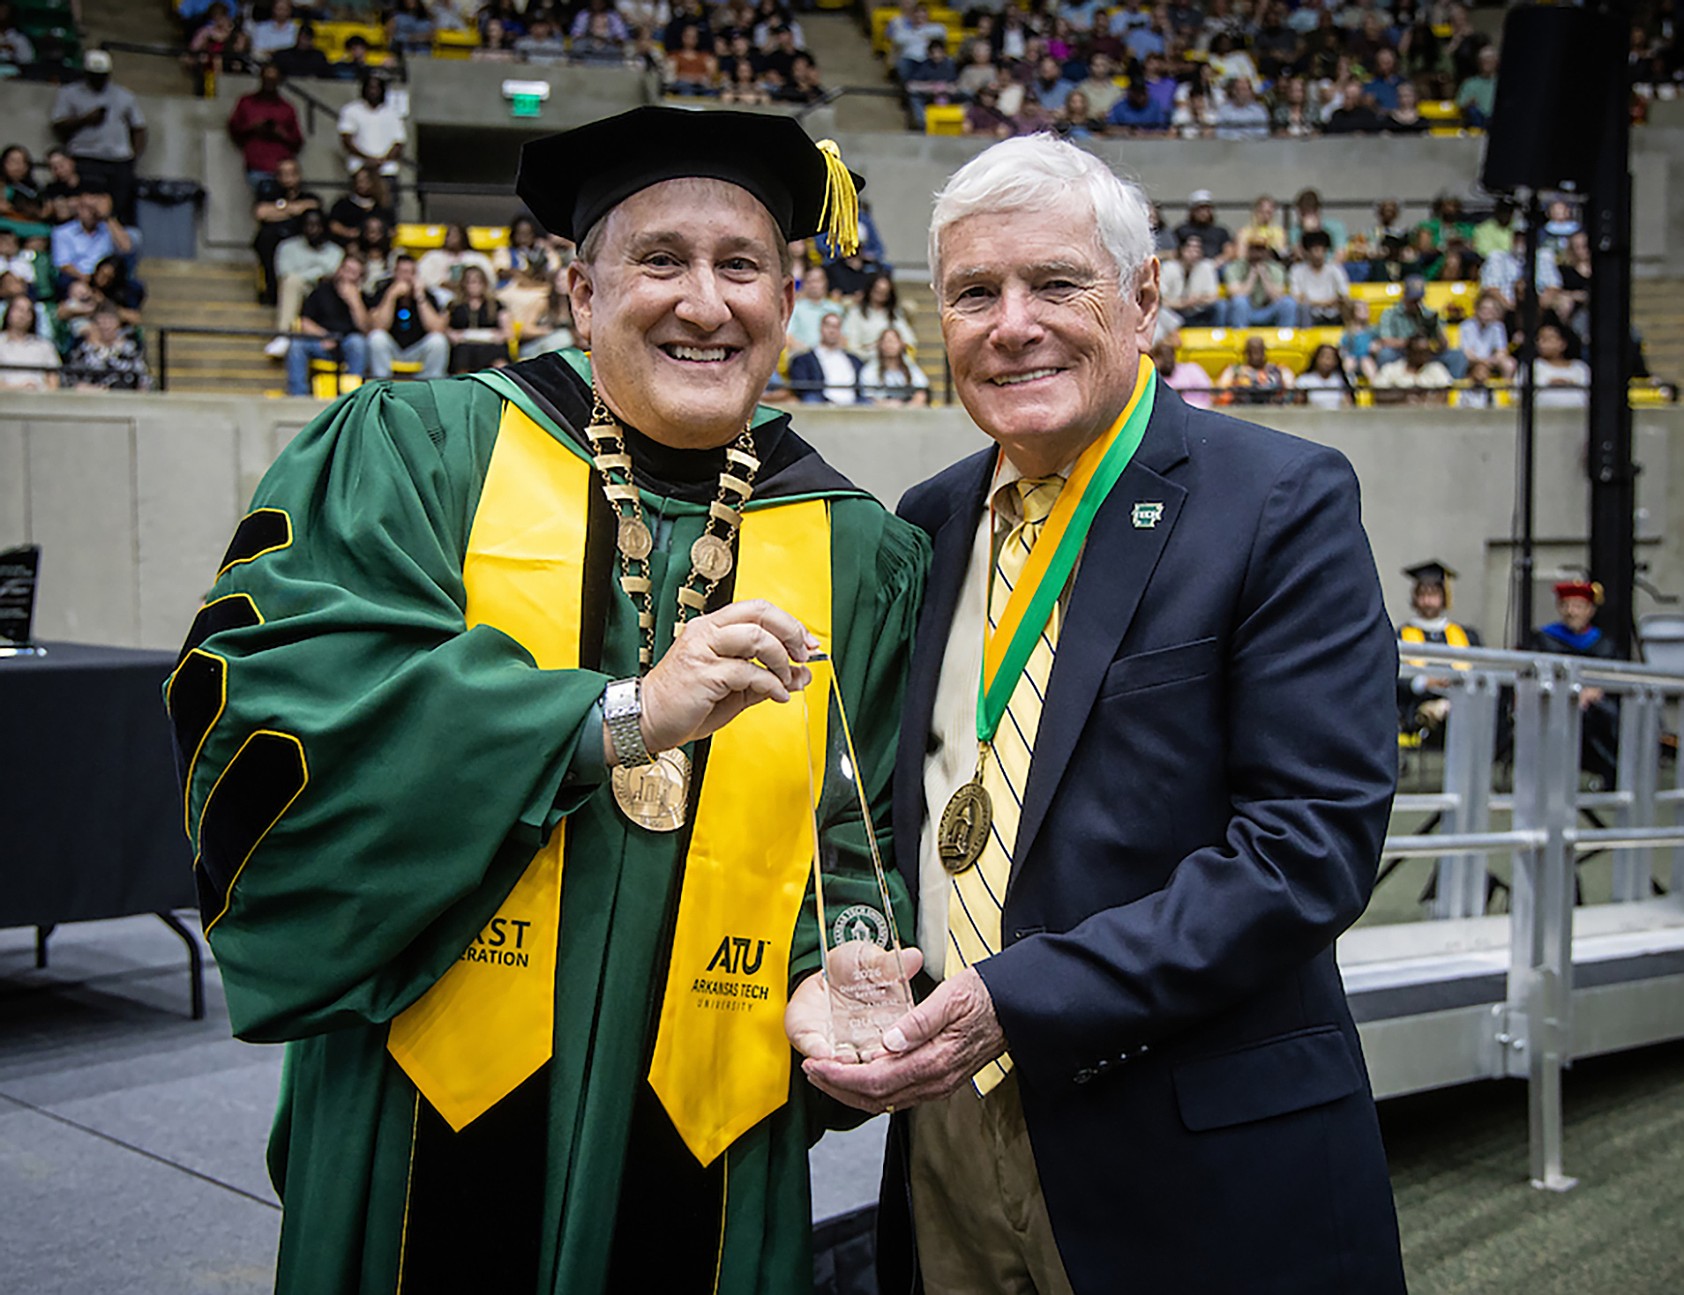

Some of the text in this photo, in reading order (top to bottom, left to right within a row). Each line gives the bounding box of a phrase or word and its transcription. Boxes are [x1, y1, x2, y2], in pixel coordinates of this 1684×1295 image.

[706, 935, 765, 975] ATU
[691, 979, 769, 1000] ARKANSAS TECH
[697, 999, 753, 1012] UNIVERSITY
